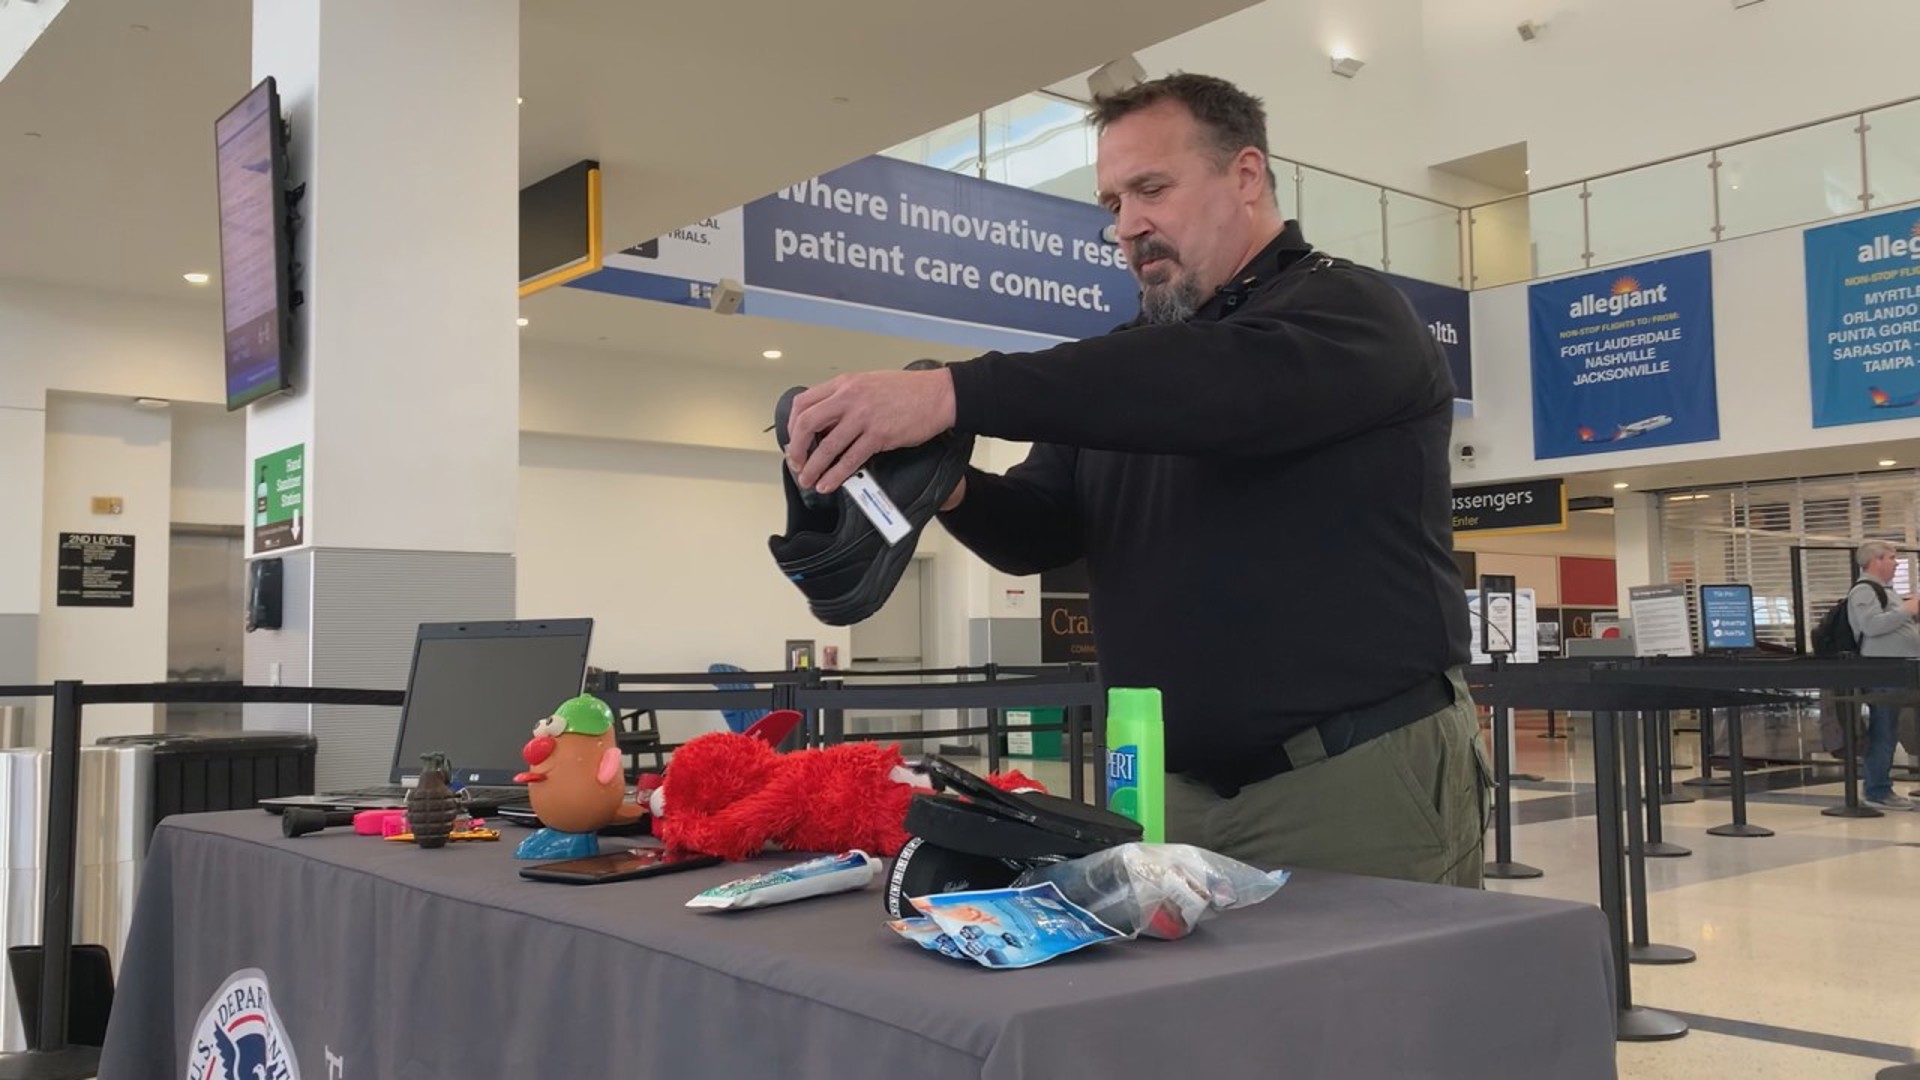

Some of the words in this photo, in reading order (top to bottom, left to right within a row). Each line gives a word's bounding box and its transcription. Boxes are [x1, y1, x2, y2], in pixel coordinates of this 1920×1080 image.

[777, 176, 889, 221] Where
[900, 193, 1064, 256] innovative
[775, 228, 905, 276] patient
[914, 255, 981, 289] care
[989, 269, 1111, 313] connect.
[1569, 283, 1667, 318] allegiant
[1842, 303, 1918, 325] ORLANDO
[1560, 341, 1594, 358] FORT
[1595, 327, 1682, 352] LAUDERDALE
[1827, 327, 1876, 344] PUNTA
[1585, 347, 1656, 369] NASHVILLE
[1833, 339, 1912, 361] SARASOTA
[1573, 360, 1670, 386] JACKSONVILLE
[1863, 356, 1914, 373] TAMPA
[68, 535, 91, 544] 2ND
[93, 535, 126, 545] LEVEL
[1051, 608, 1094, 635] Cra
